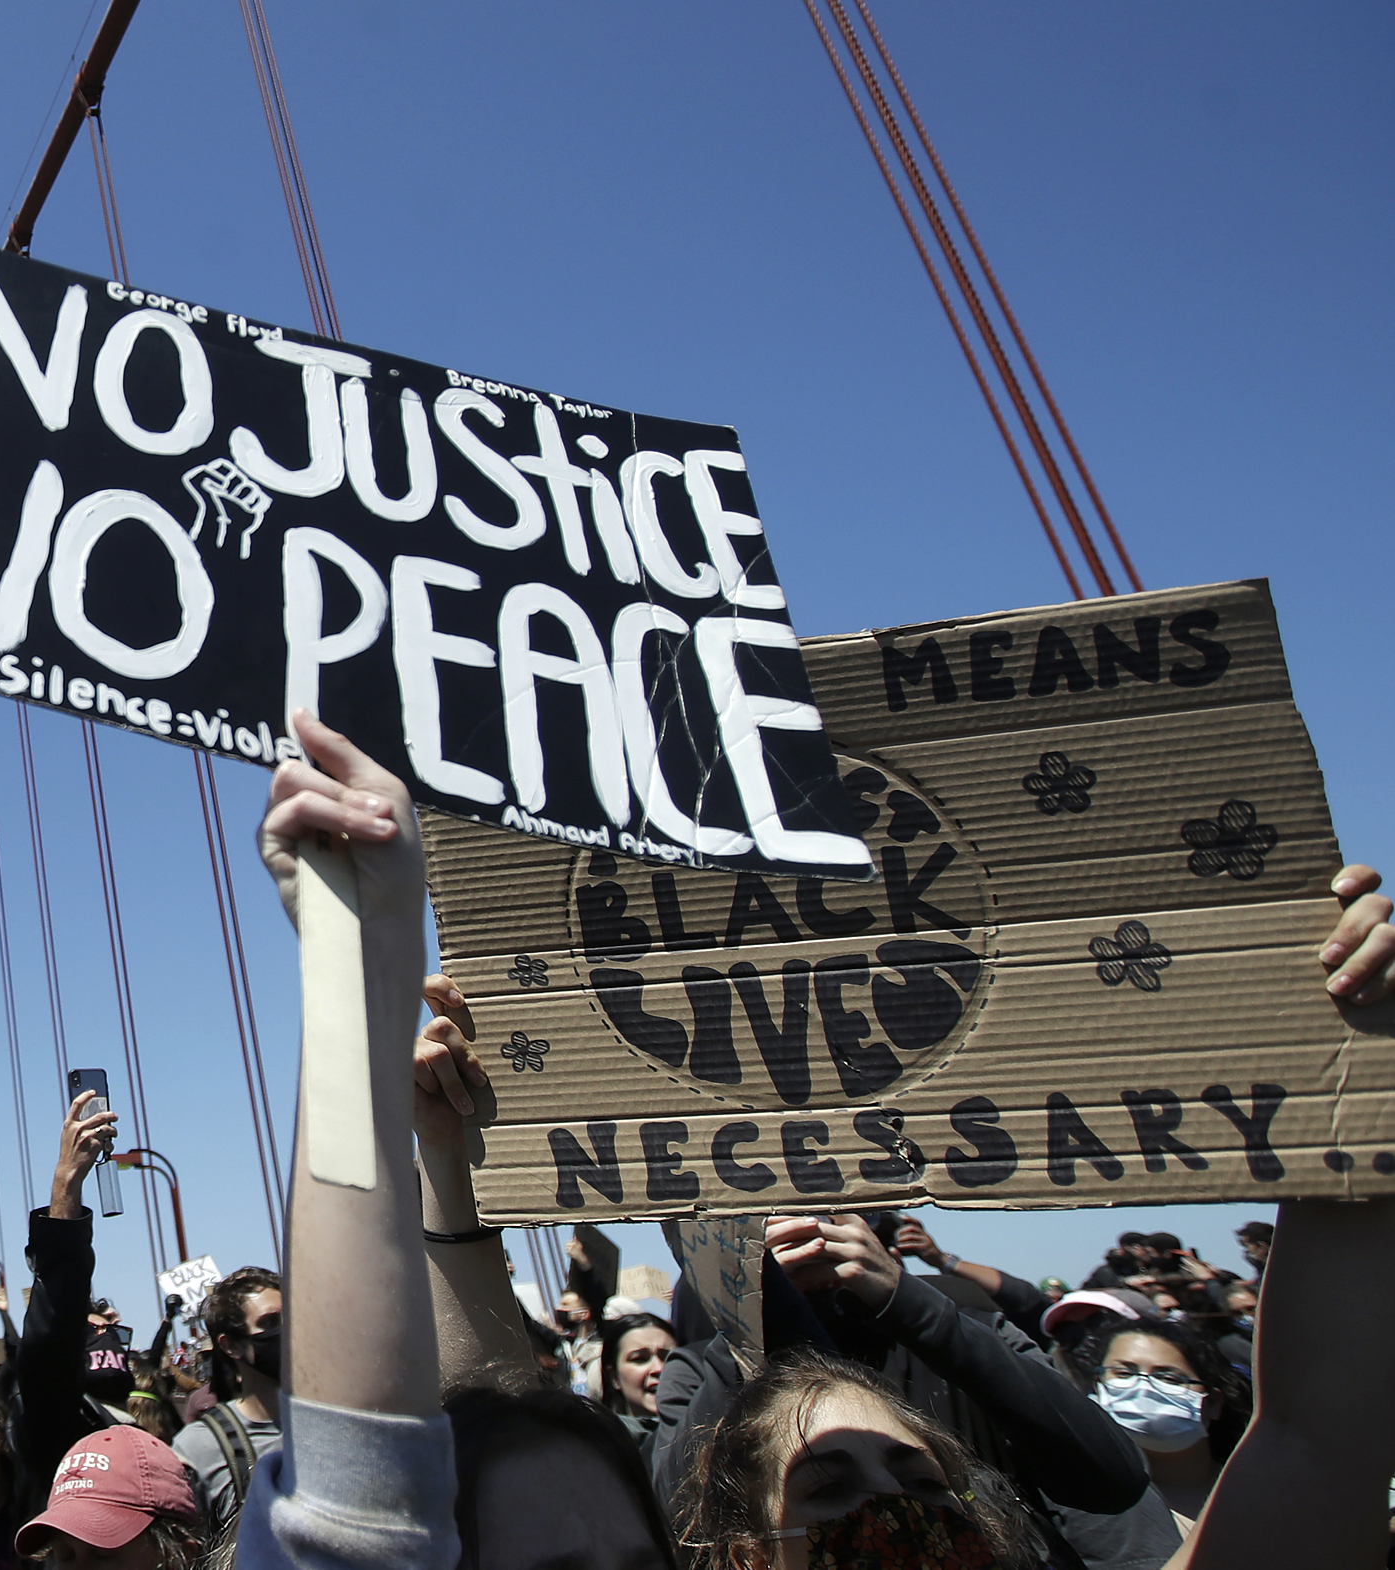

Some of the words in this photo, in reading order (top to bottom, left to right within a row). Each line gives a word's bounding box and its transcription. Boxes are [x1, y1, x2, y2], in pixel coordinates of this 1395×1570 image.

[107, 281, 208, 324] George
[226, 313, 284, 341] Floyd
[446, 369, 543, 404] Breonna
[548, 393, 613, 419] Taylor
[283, 527, 873, 865] PEACE
[882, 609, 1232, 712] MEANS
[501, 804, 611, 848] Ahmaud
[618, 832, 698, 868] Arbery
[575, 842, 973, 963] BLACK
[589, 940, 982, 1106] LIVES
